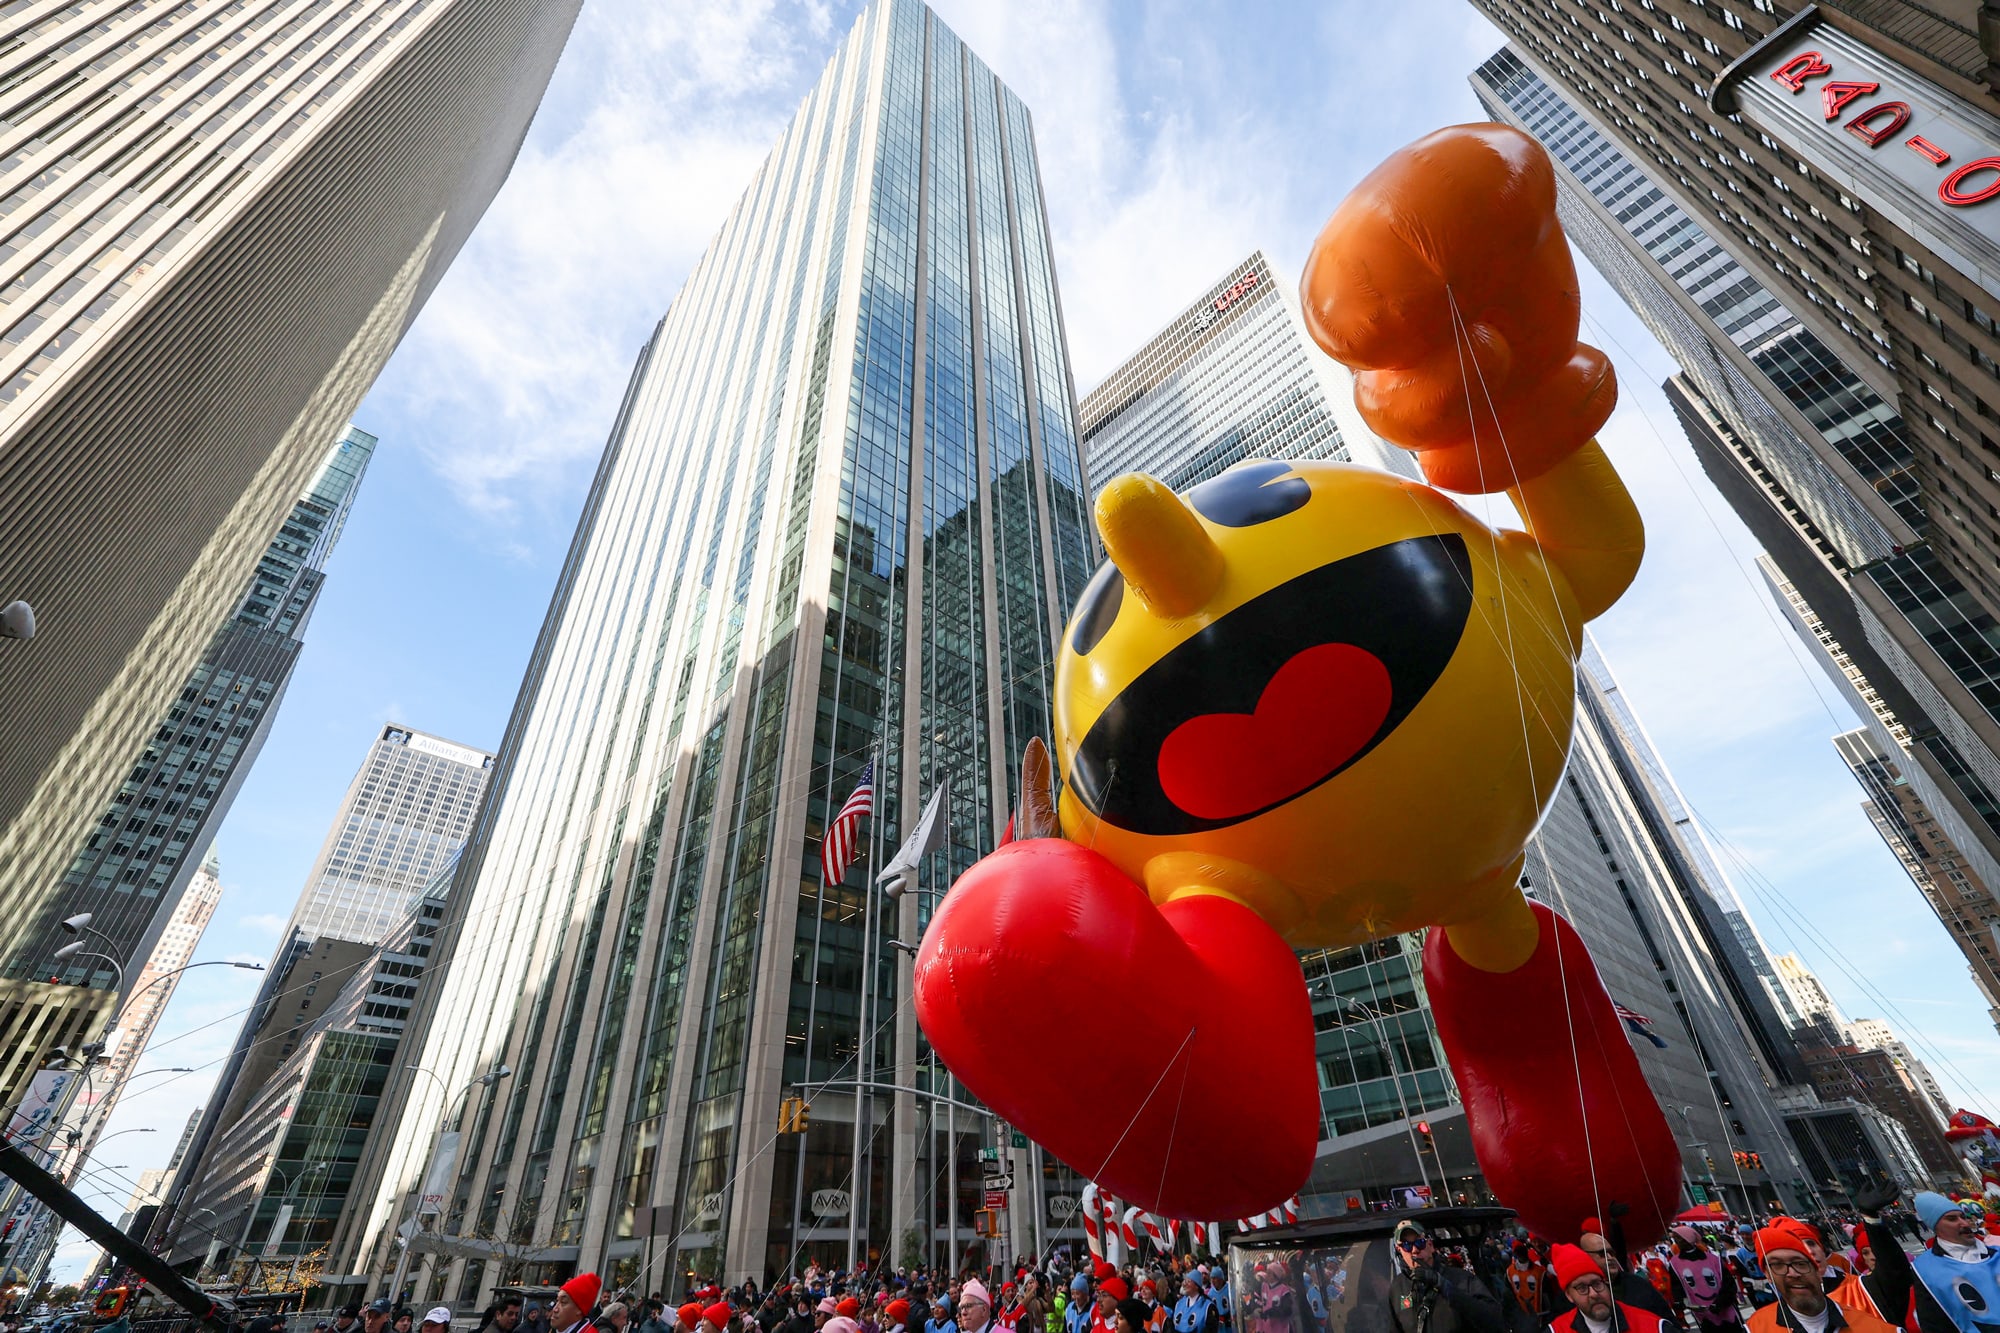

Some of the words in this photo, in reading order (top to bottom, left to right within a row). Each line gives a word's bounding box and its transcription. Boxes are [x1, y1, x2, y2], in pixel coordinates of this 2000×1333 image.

[1215, 272, 1258, 311] UBS
[419, 740, 459, 757] Allianz
[814, 1193, 848, 1209] AVRA
[1052, 1199, 1075, 1211] AVRA
